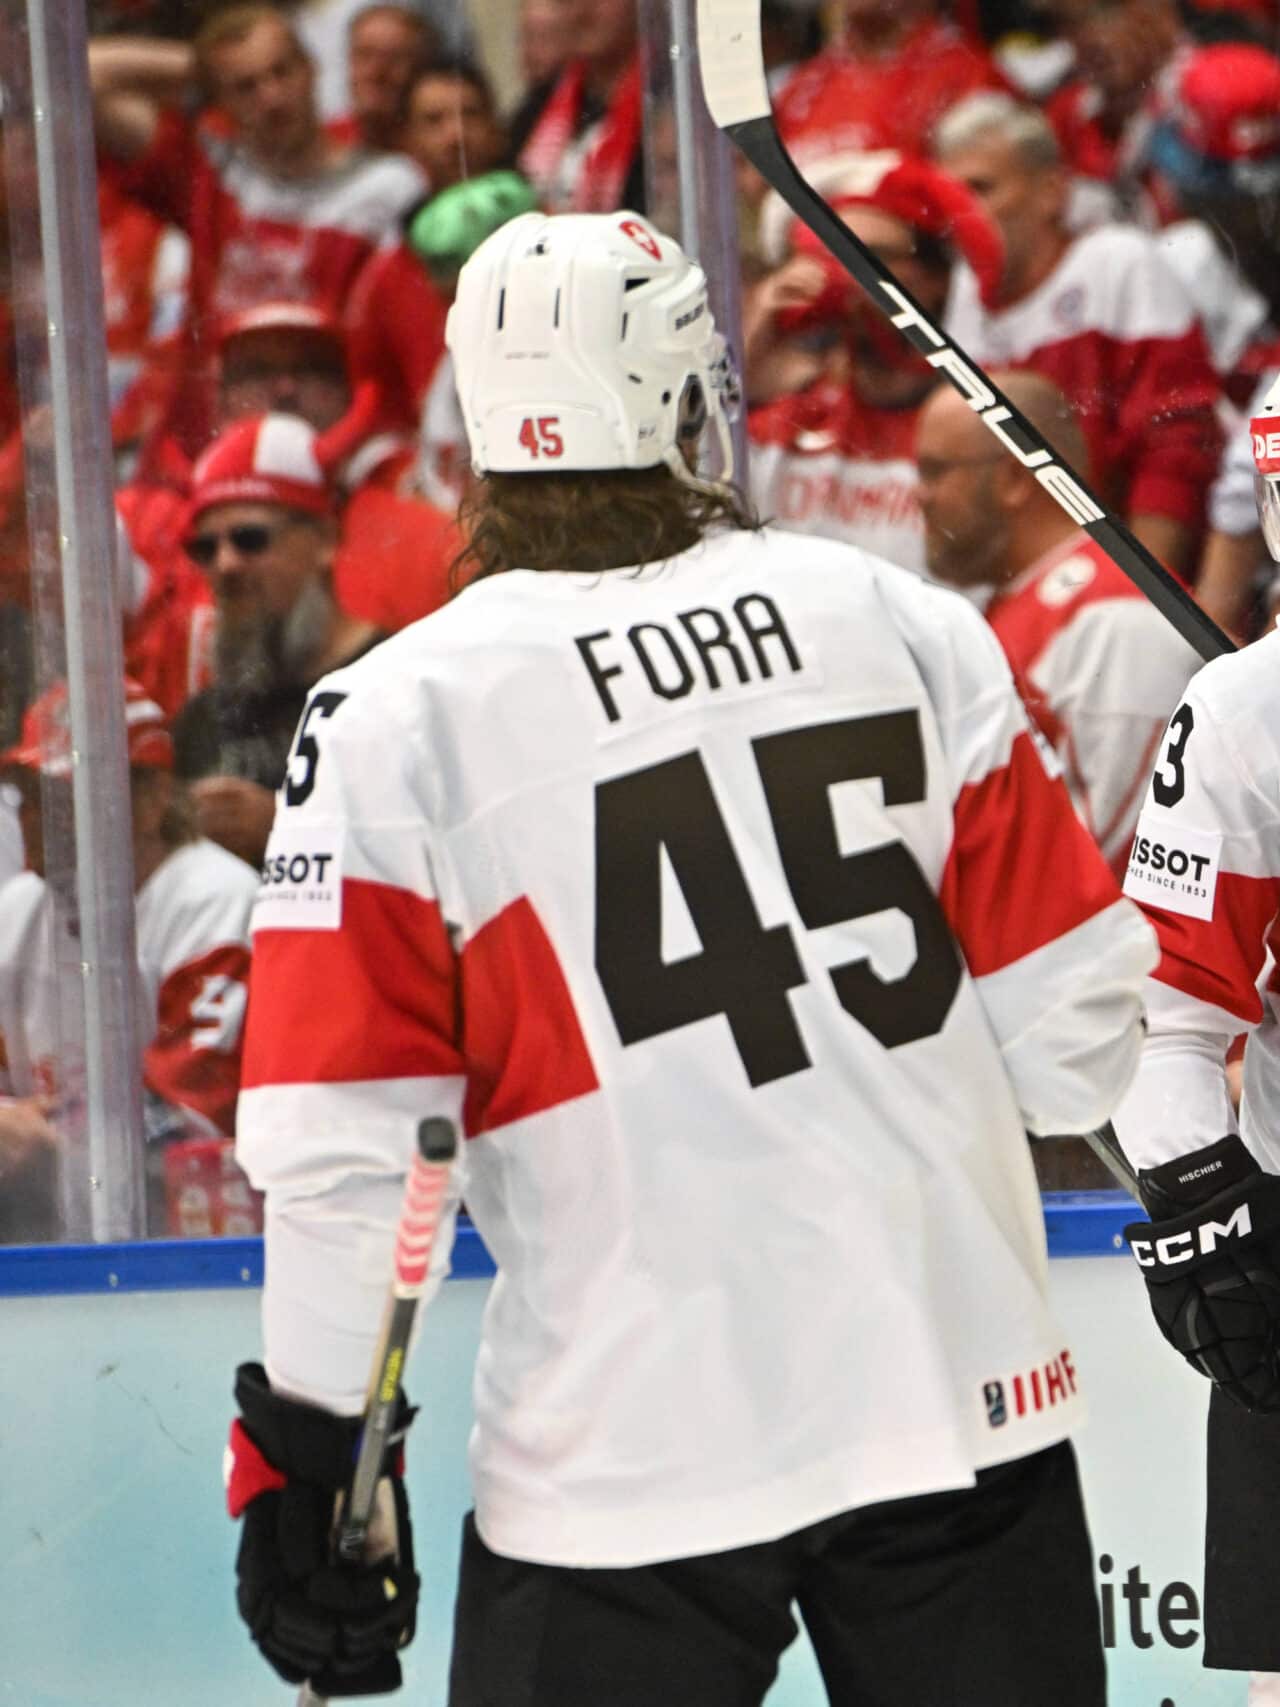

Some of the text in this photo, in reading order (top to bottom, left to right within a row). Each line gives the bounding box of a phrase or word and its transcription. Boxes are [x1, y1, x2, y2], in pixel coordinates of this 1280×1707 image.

[519, 417, 564, 459] 45
[877, 280, 1106, 526] TRUE
[574, 593, 803, 723] FORA
[1153, 703, 1194, 808] 3
[595, 707, 964, 1088] 45
[1132, 836, 1210, 882] ISSOT
[1178, 1160, 1223, 1184] HISCHIER
[1130, 1203, 1252, 1267] CCM
[1013, 1349, 1076, 1418] IIHF
[1099, 1554, 1200, 1649] ite
